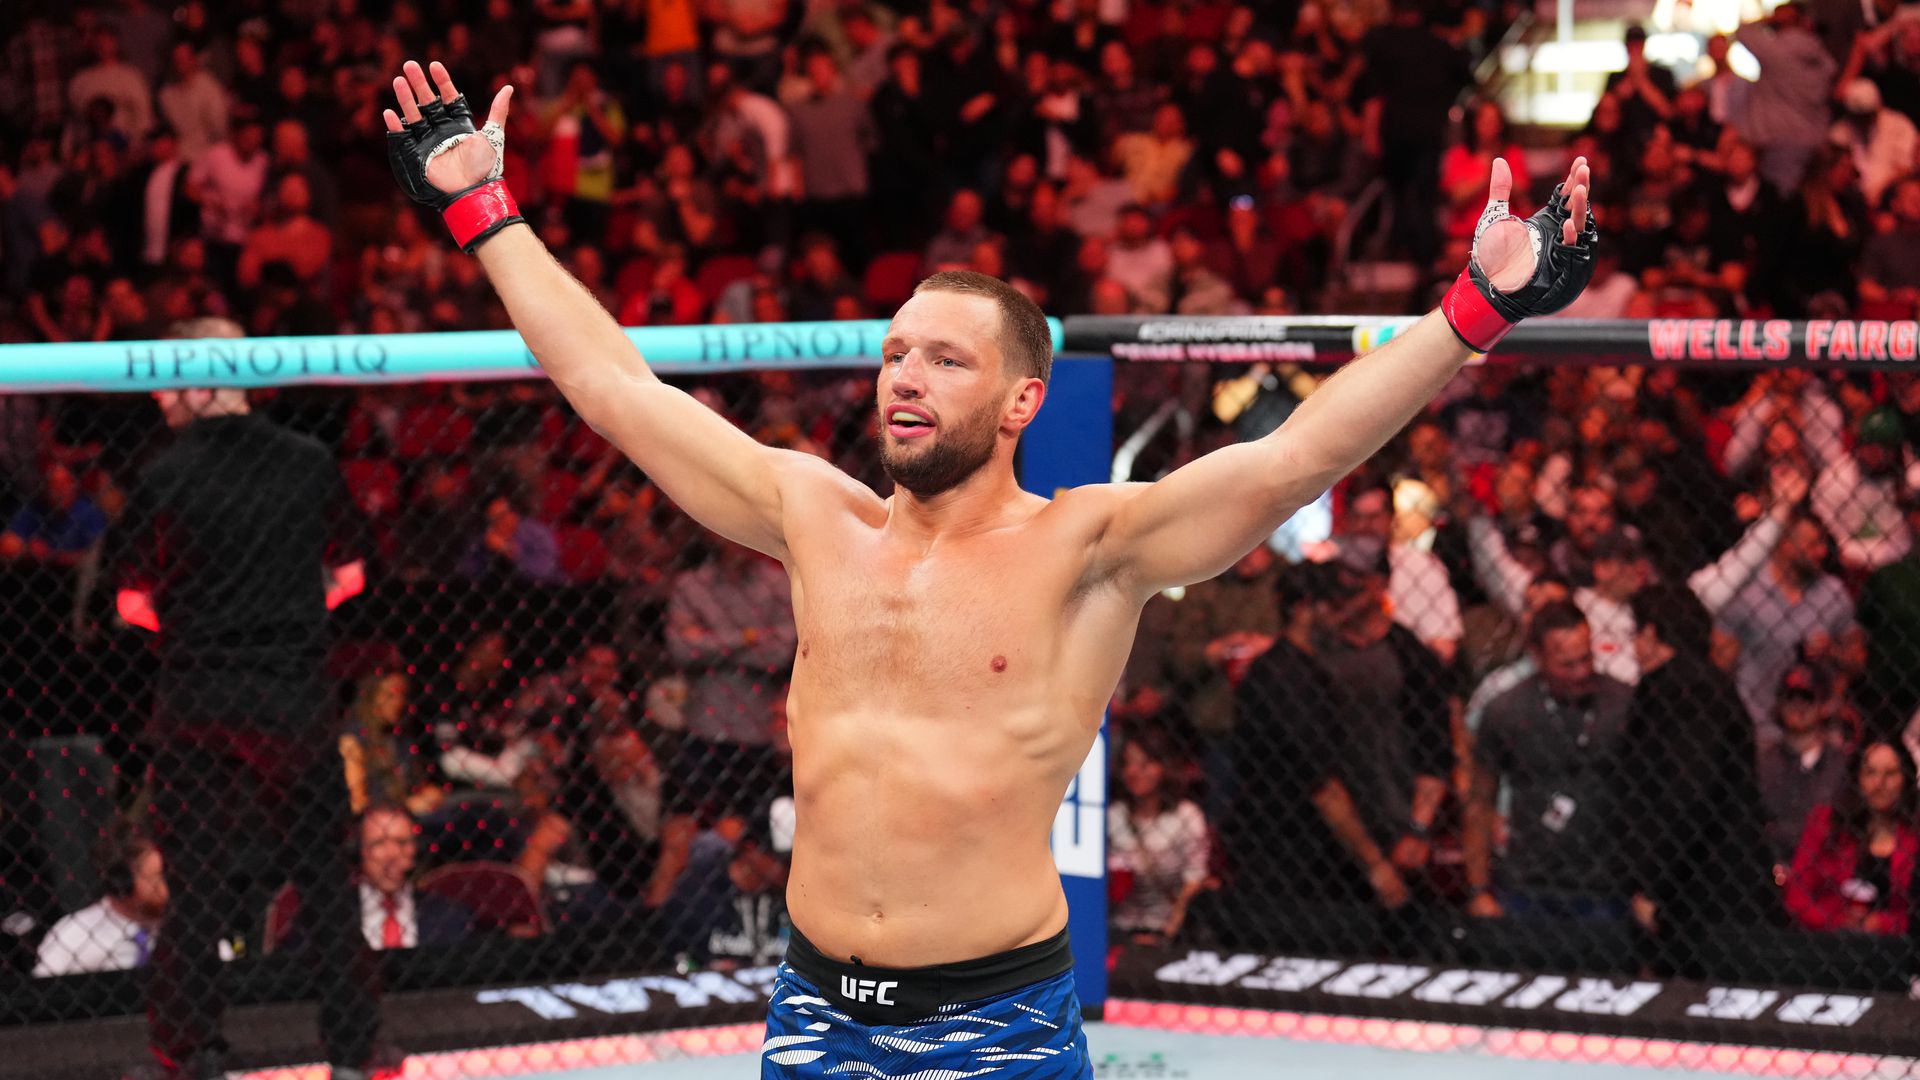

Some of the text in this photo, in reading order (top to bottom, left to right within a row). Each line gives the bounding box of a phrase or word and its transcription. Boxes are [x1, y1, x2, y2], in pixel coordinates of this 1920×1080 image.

[124, 337, 389, 380] HPNOTIQ
[700, 325, 869, 363] HPNOT
[1648, 319, 1920, 362] WELLS FARG
[840, 974, 898, 1006] UFC
[1154, 950, 1875, 1027] DE RIDDER
